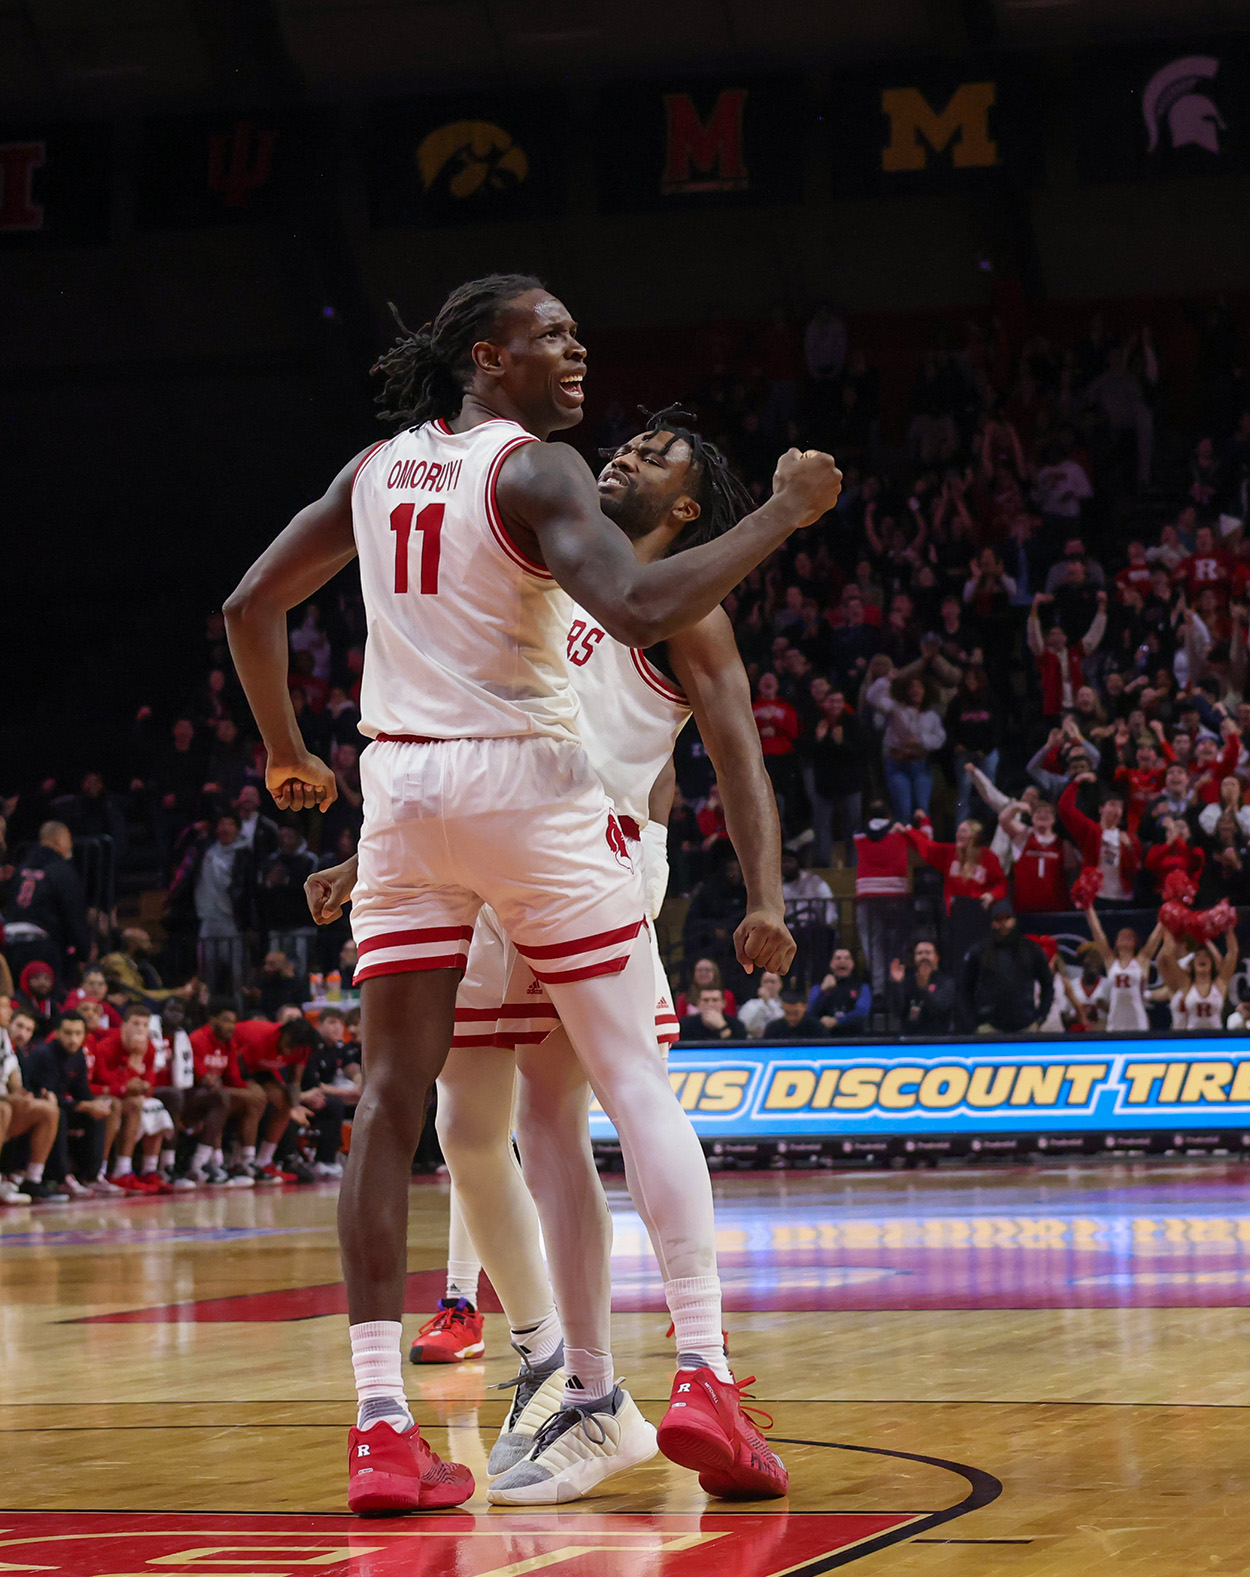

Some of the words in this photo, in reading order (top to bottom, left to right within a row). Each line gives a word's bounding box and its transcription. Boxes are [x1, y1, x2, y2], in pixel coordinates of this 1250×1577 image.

[881, 82, 1000, 172] M
[387, 459, 463, 493] OMORUYI
[389, 503, 446, 595] 11
[763, 1063, 1109, 1110] DISCOUNT
[677, 1383, 691, 1393] R
[357, 1444, 370, 1457] R
